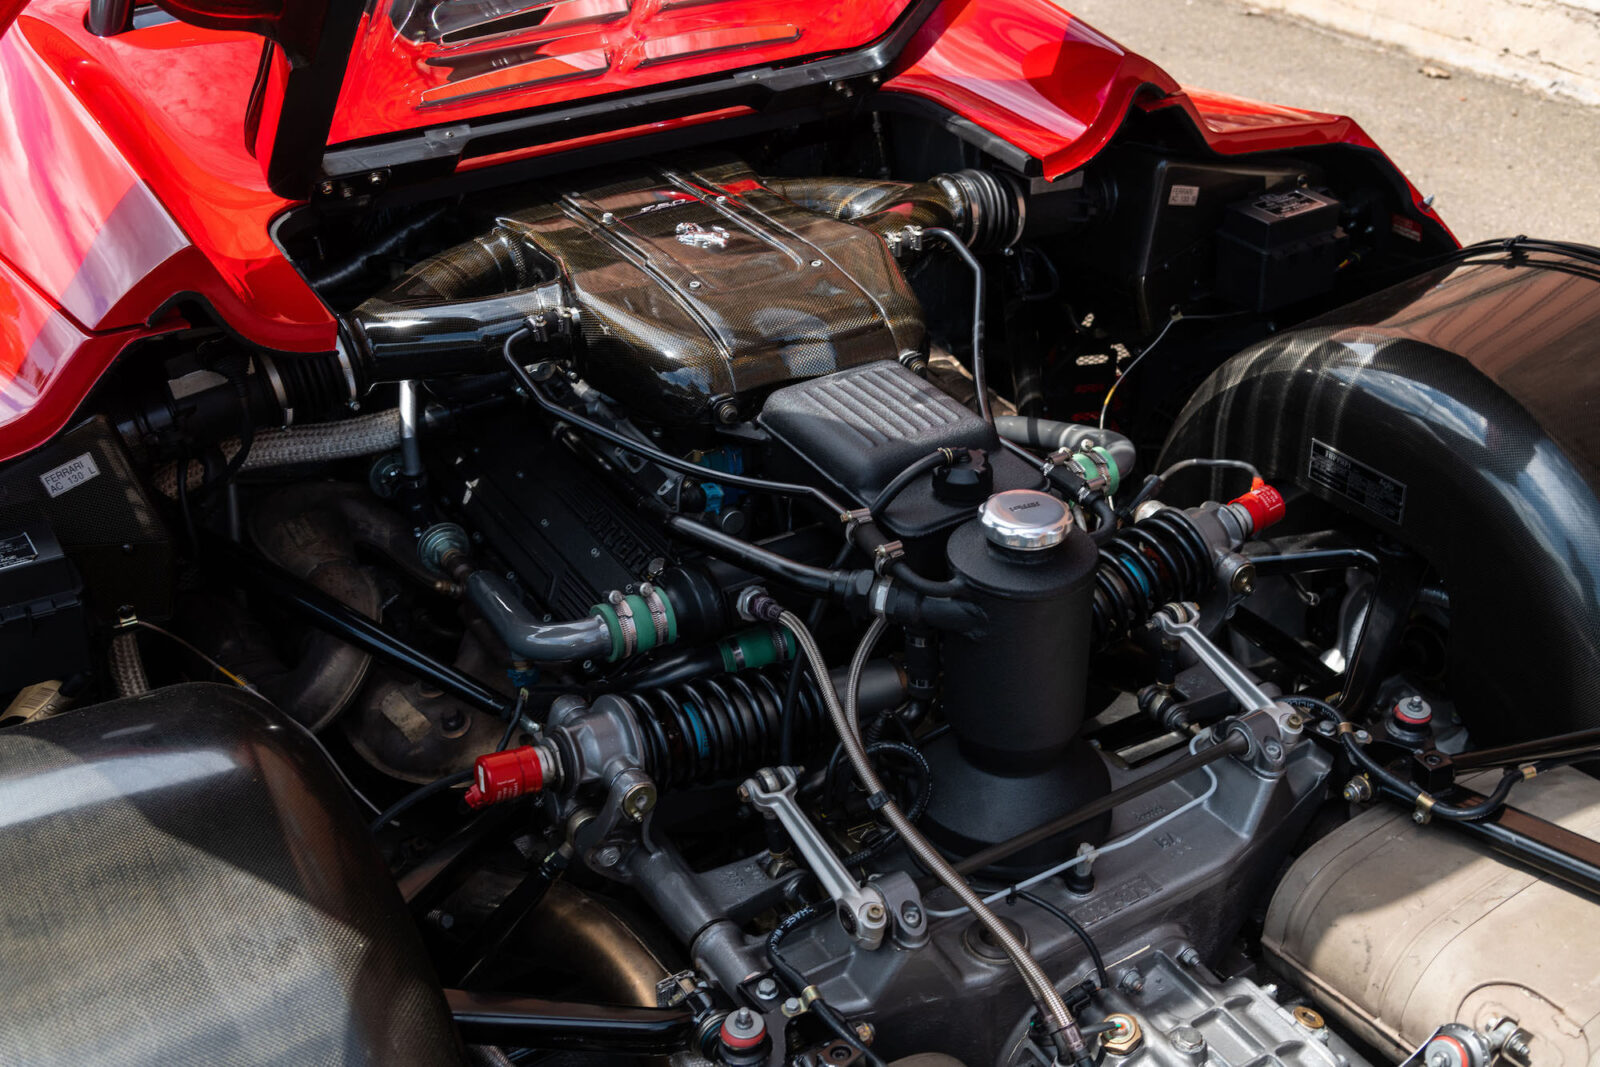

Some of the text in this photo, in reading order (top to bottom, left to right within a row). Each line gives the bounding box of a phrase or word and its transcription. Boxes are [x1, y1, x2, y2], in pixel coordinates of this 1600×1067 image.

[44, 460, 84, 485] FERRARI
[50, 466, 97, 493] AC 130 L
